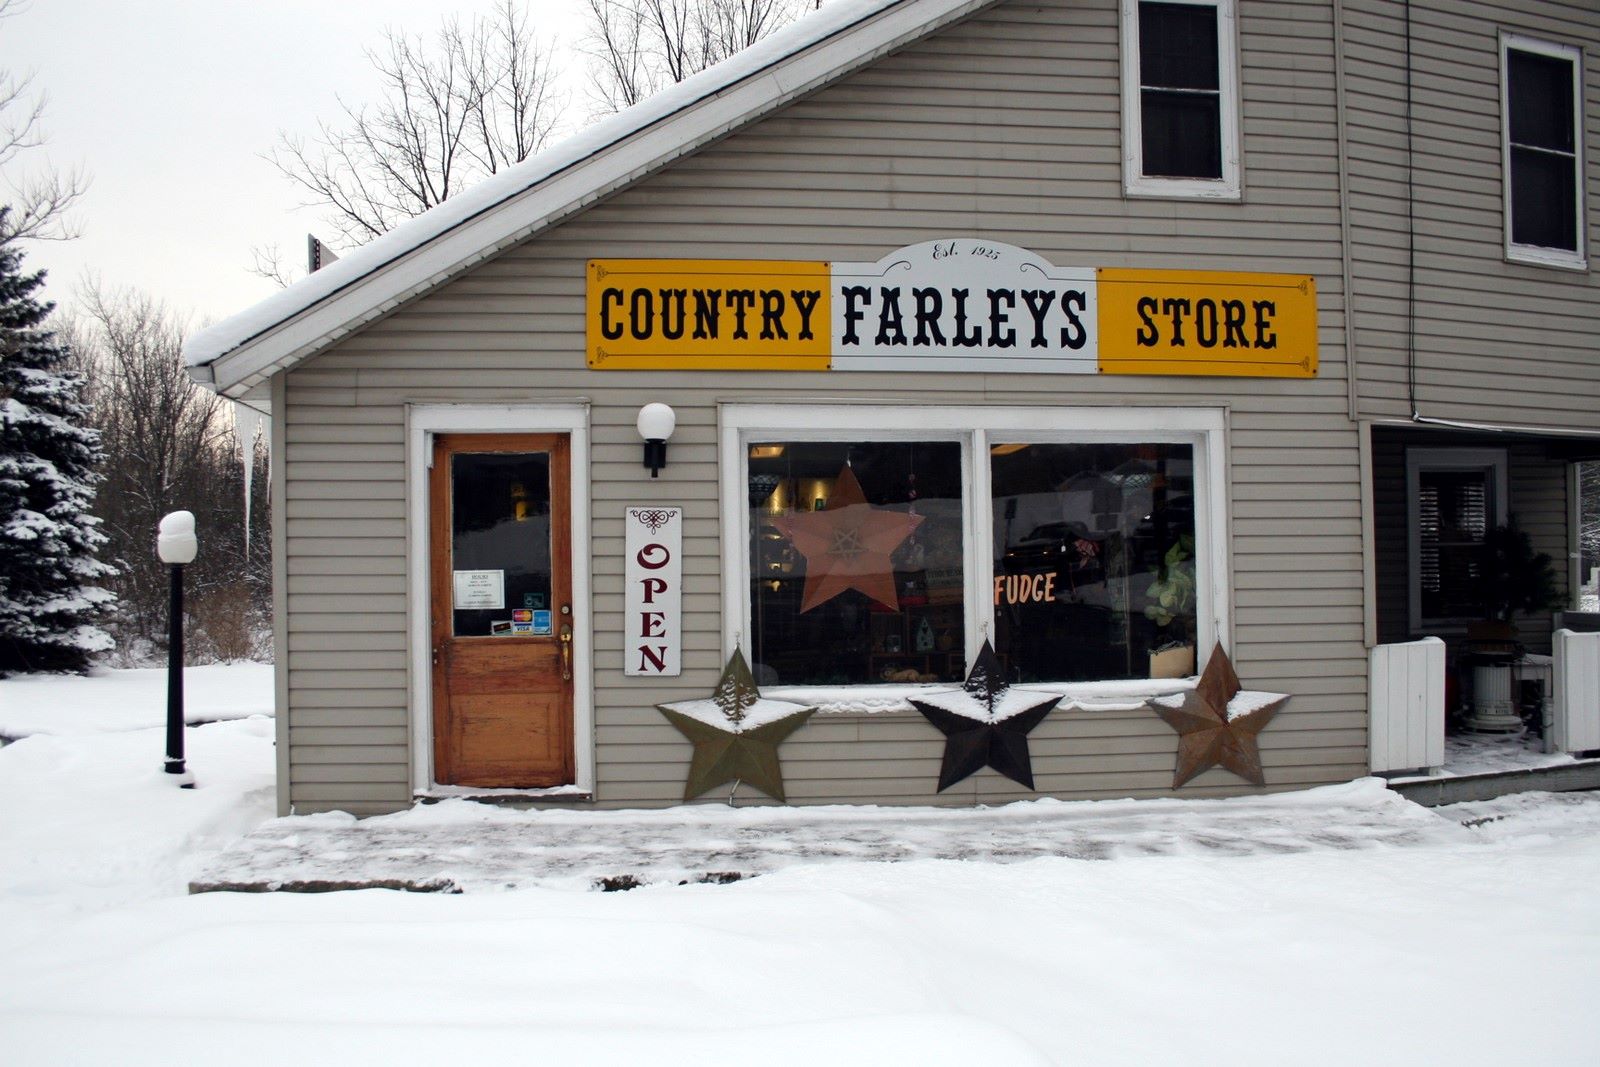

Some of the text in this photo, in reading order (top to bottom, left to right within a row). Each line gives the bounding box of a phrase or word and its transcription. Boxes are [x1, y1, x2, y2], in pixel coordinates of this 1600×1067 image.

[932, 241, 1001, 260] Est. 1925
[599, 285, 1277, 350] COUNTRY FARLEYS STORE
[636, 543, 671, 673] OPEN
[994, 572, 1057, 605] FUDGE
